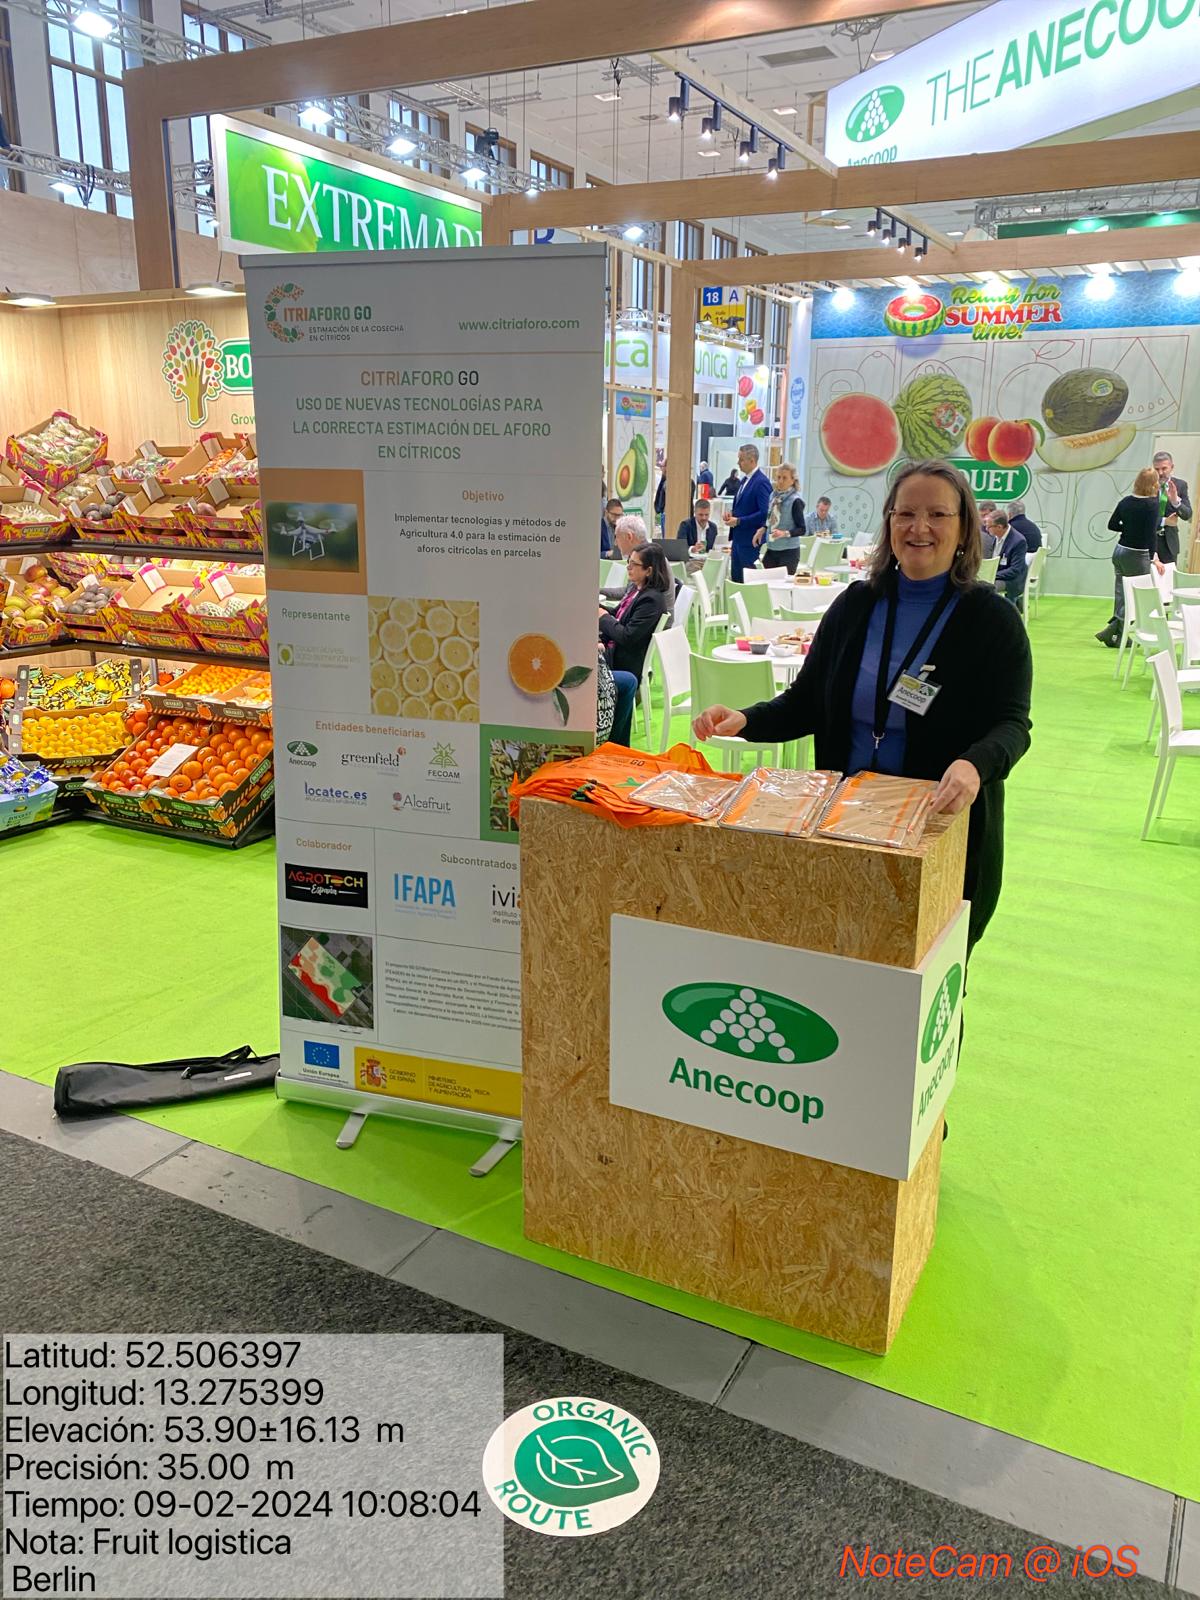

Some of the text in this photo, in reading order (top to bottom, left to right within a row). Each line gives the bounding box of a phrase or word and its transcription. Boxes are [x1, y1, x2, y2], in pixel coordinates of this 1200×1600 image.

[994, 0, 1200, 98] ANECOO
[261, 165, 482, 250] EXTREMAD
[706, 290, 738, 303] 18 A
[354, 306, 371, 321] GO
[944, 302, 1062, 326] SUMMER
[309, 325, 348, 334] ESTIMACIÓN
[361, 325, 369, 333] LA
[458, 318, 580, 331] www.citriaforo.com
[606, 340, 649, 368] ica
[225, 353, 252, 379] BO
[360, 370, 479, 386] CITRIAFORO GO
[296, 394, 543, 411] USO DE NUEVAS TECNOLOGÍAS PARA
[293, 419, 550, 436] LA CORRECTA ESTIMACIÓN DEL AFORO
[378, 443, 461, 459] EN CÍTRICOS
[958, 469, 1019, 491] UET
[462, 489, 504, 503] Objetivo
[394, 512, 448, 525] Implementar
[504, 520, 510, 528] y
[512, 517, 552, 528] métodos
[554, 518, 566, 528] de
[400, 528, 561, 543] Agricultura 4.0 para la estimación de
[417, 544, 445, 555] aforos
[490, 548, 501, 556] en
[504, 547, 541, 559] parcelas
[282, 608, 351, 622] Representante
[315, 720, 426, 738] Entidades beneficiarias
[289, 757, 316, 767] Anecoop
[341, 752, 400, 767] greenfield
[428, 770, 460, 779] FECOAM
[305, 780, 367, 800] locatec.es
[403, 794, 451, 811] Alcafruit
[296, 838, 352, 851] Colaborador
[440, 853, 518, 871] Subcontratados
[394, 873, 456, 907] IFAPA
[493, 909, 517, 917] instituto
[917, 1037, 955, 1126] Anecoop
[669, 1057, 825, 1124] Anecoop
[533, 1401, 651, 1459] ORGANIC
[494, 1479, 592, 1530] ROUTE
